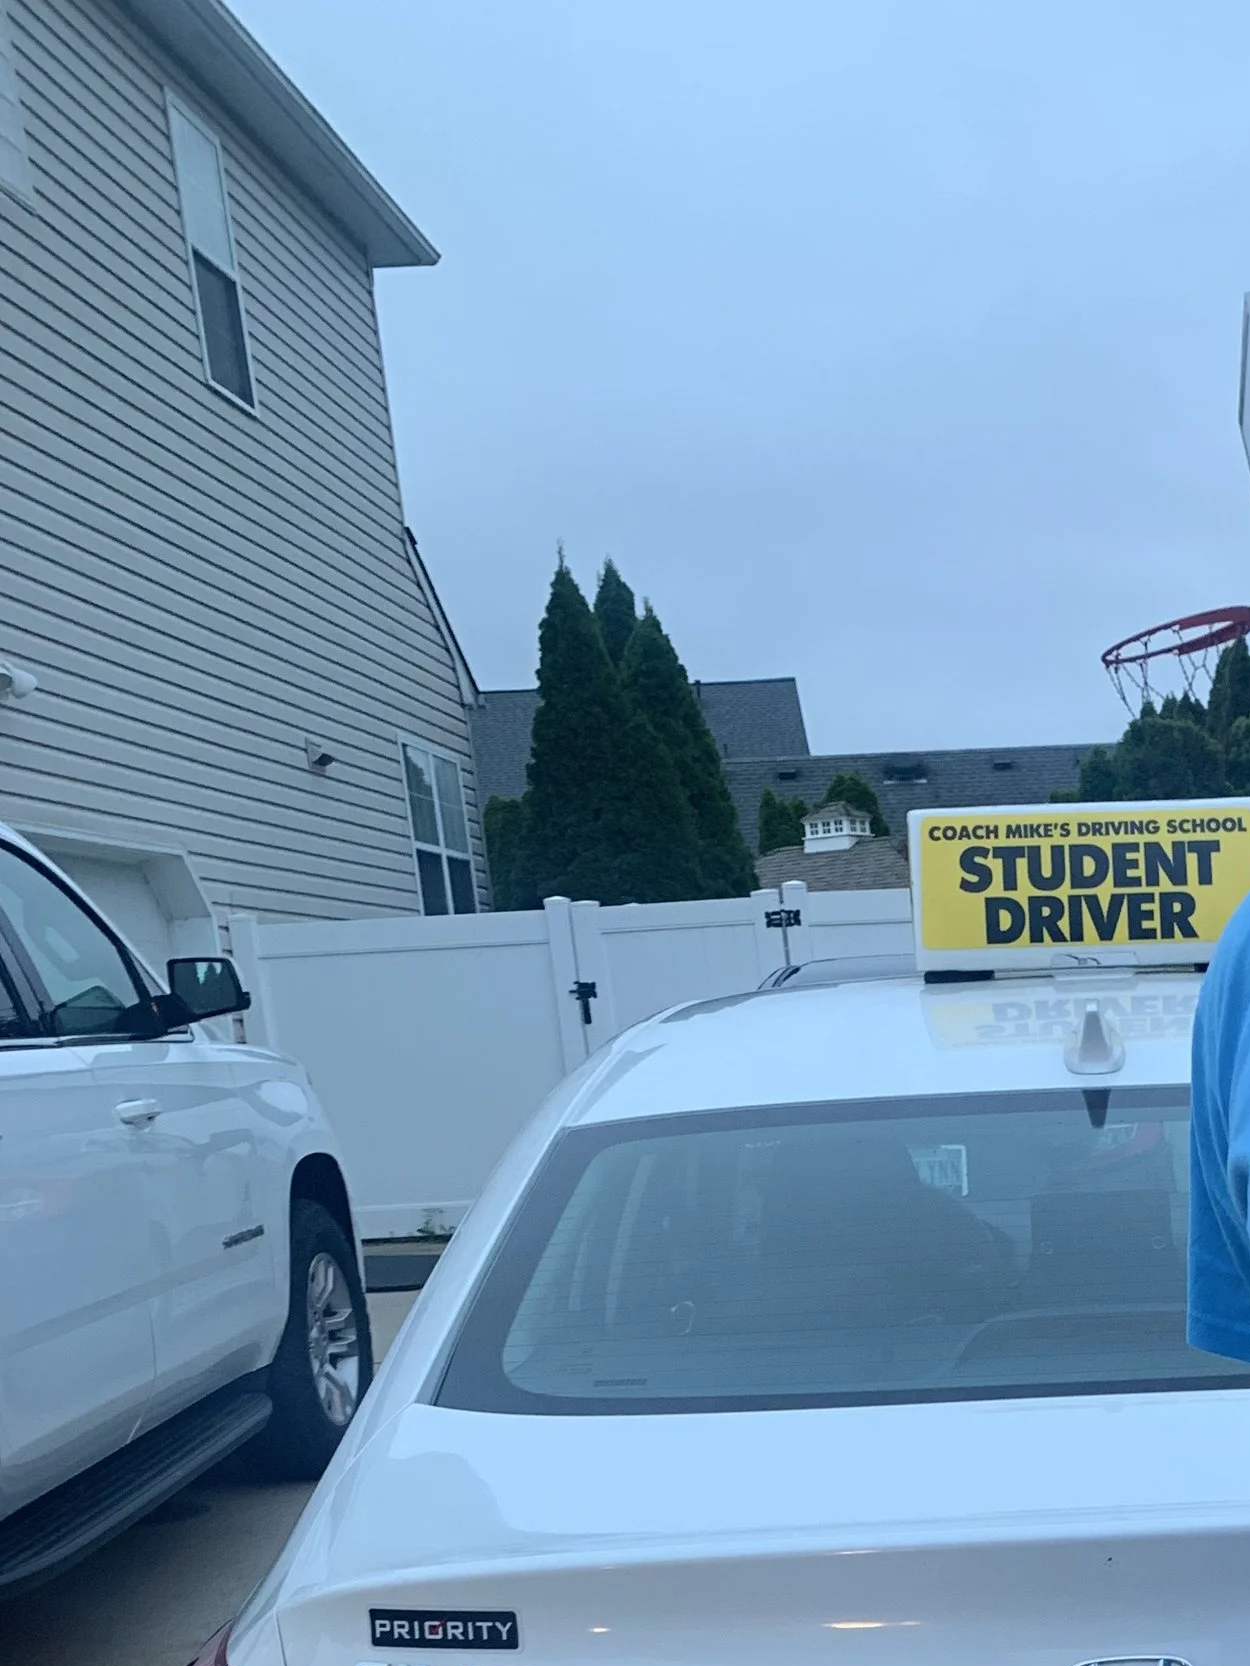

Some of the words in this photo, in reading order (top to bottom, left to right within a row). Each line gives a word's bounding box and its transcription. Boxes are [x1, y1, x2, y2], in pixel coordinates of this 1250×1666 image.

[928, 824, 999, 841] COACH
[1005, 822, 1071, 839] MIKE'S
[1077, 819, 1160, 837] DRIVING
[1167, 817, 1247, 834] SCHOOL
[959, 839, 1220, 893] STUDENT
[984, 891, 1199, 944] DRIVER
[375, 1619, 512, 1641] PRIORITY
